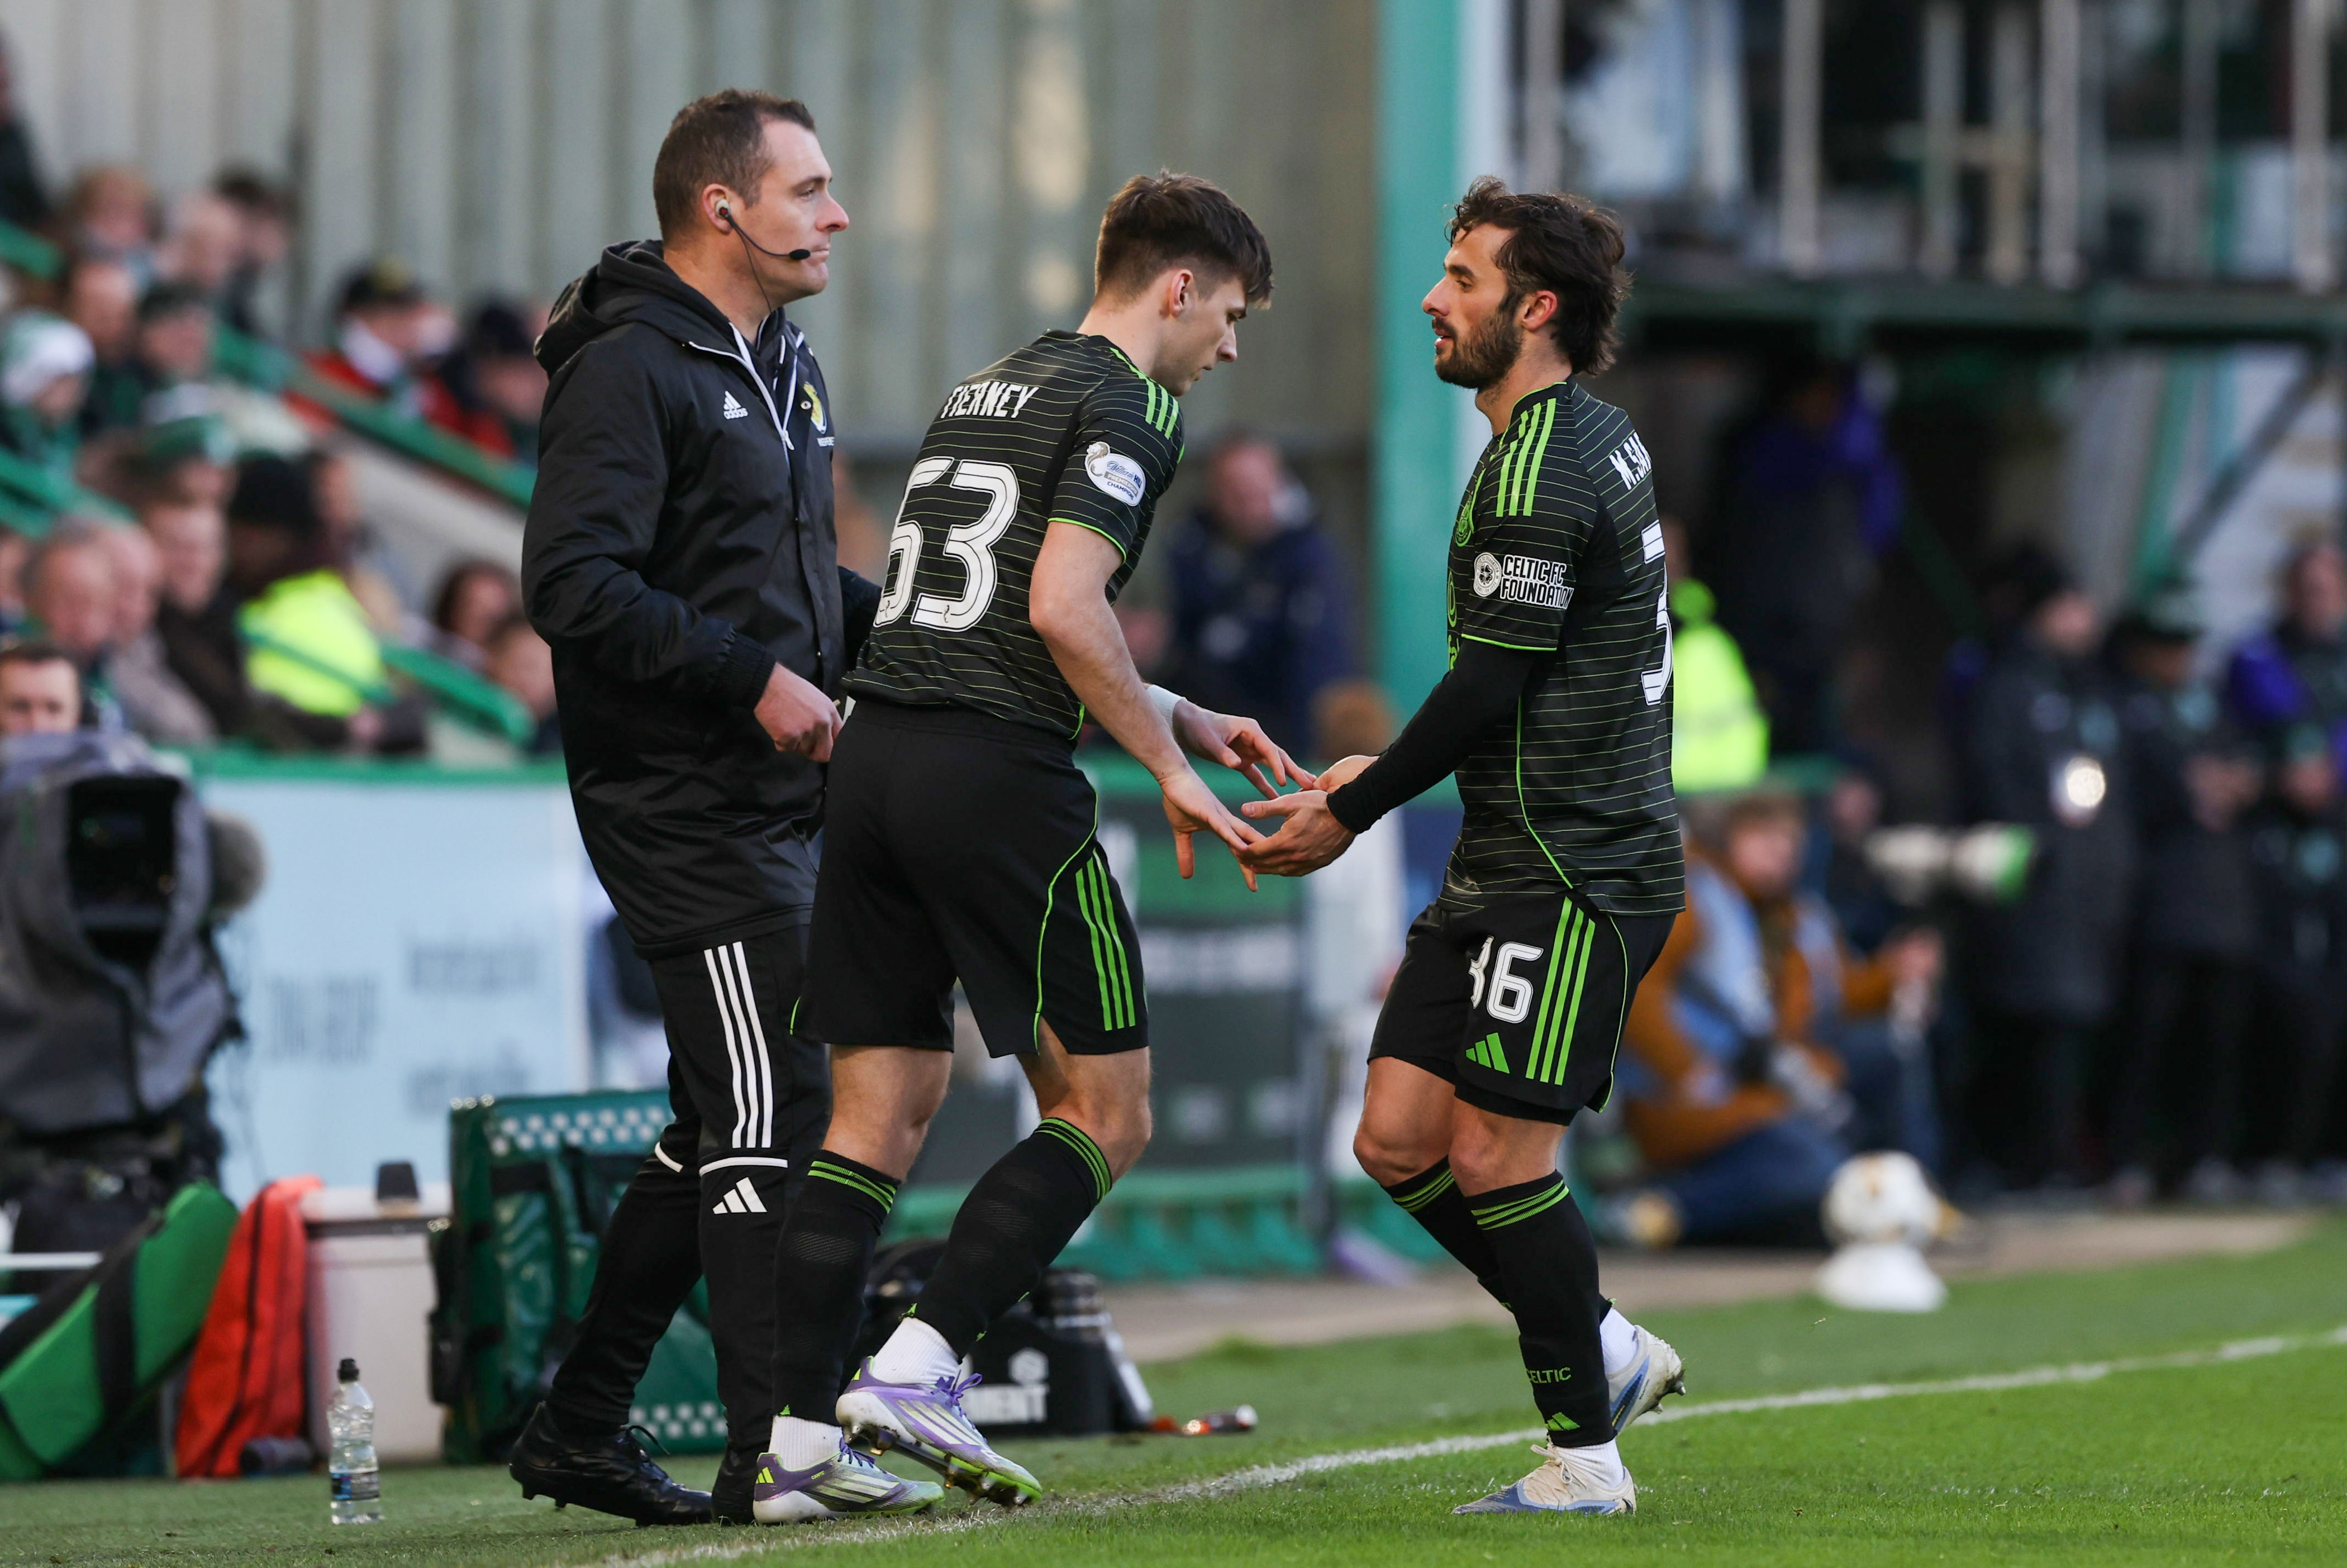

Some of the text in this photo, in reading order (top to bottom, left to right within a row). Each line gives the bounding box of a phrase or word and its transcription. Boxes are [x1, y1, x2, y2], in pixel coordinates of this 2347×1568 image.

[723, 407, 749, 420] adidas
[940, 381, 1040, 419] TIERNEY
[1503, 555, 1550, 583] CELTIC
[1550, 562, 1567, 585] FC
[1500, 576, 1574, 610] FOUNDATION
